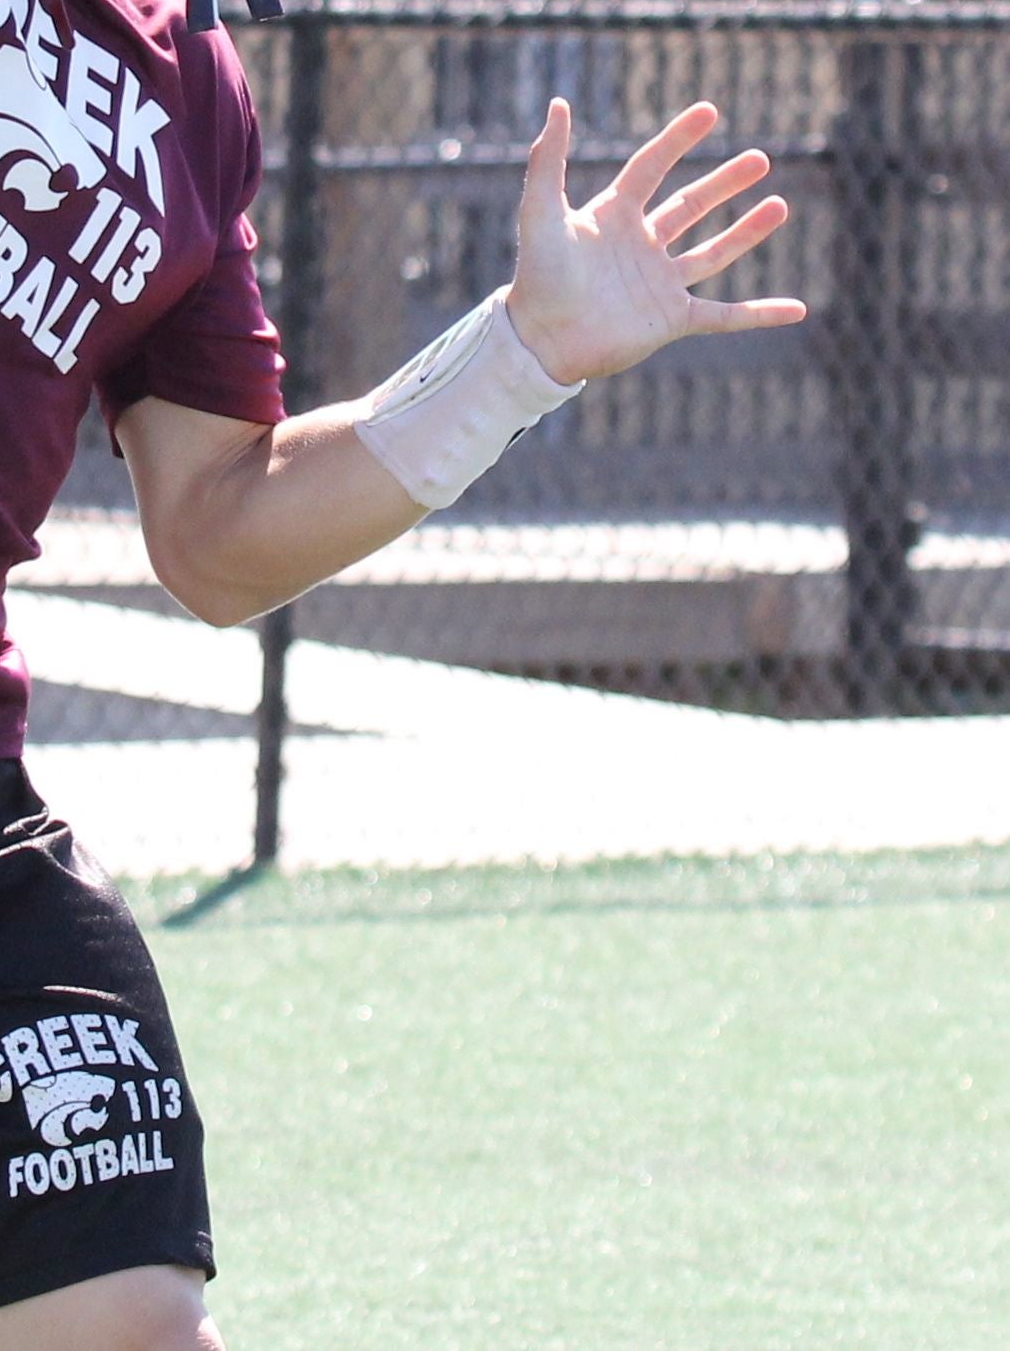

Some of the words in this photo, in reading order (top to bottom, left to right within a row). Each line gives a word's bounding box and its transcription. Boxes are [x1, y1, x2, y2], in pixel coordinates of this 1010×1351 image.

[68, 187, 163, 304] 113
[121, 1078, 183, 1123] 113
[8, 1130, 174, 1198] FOOTBALL
